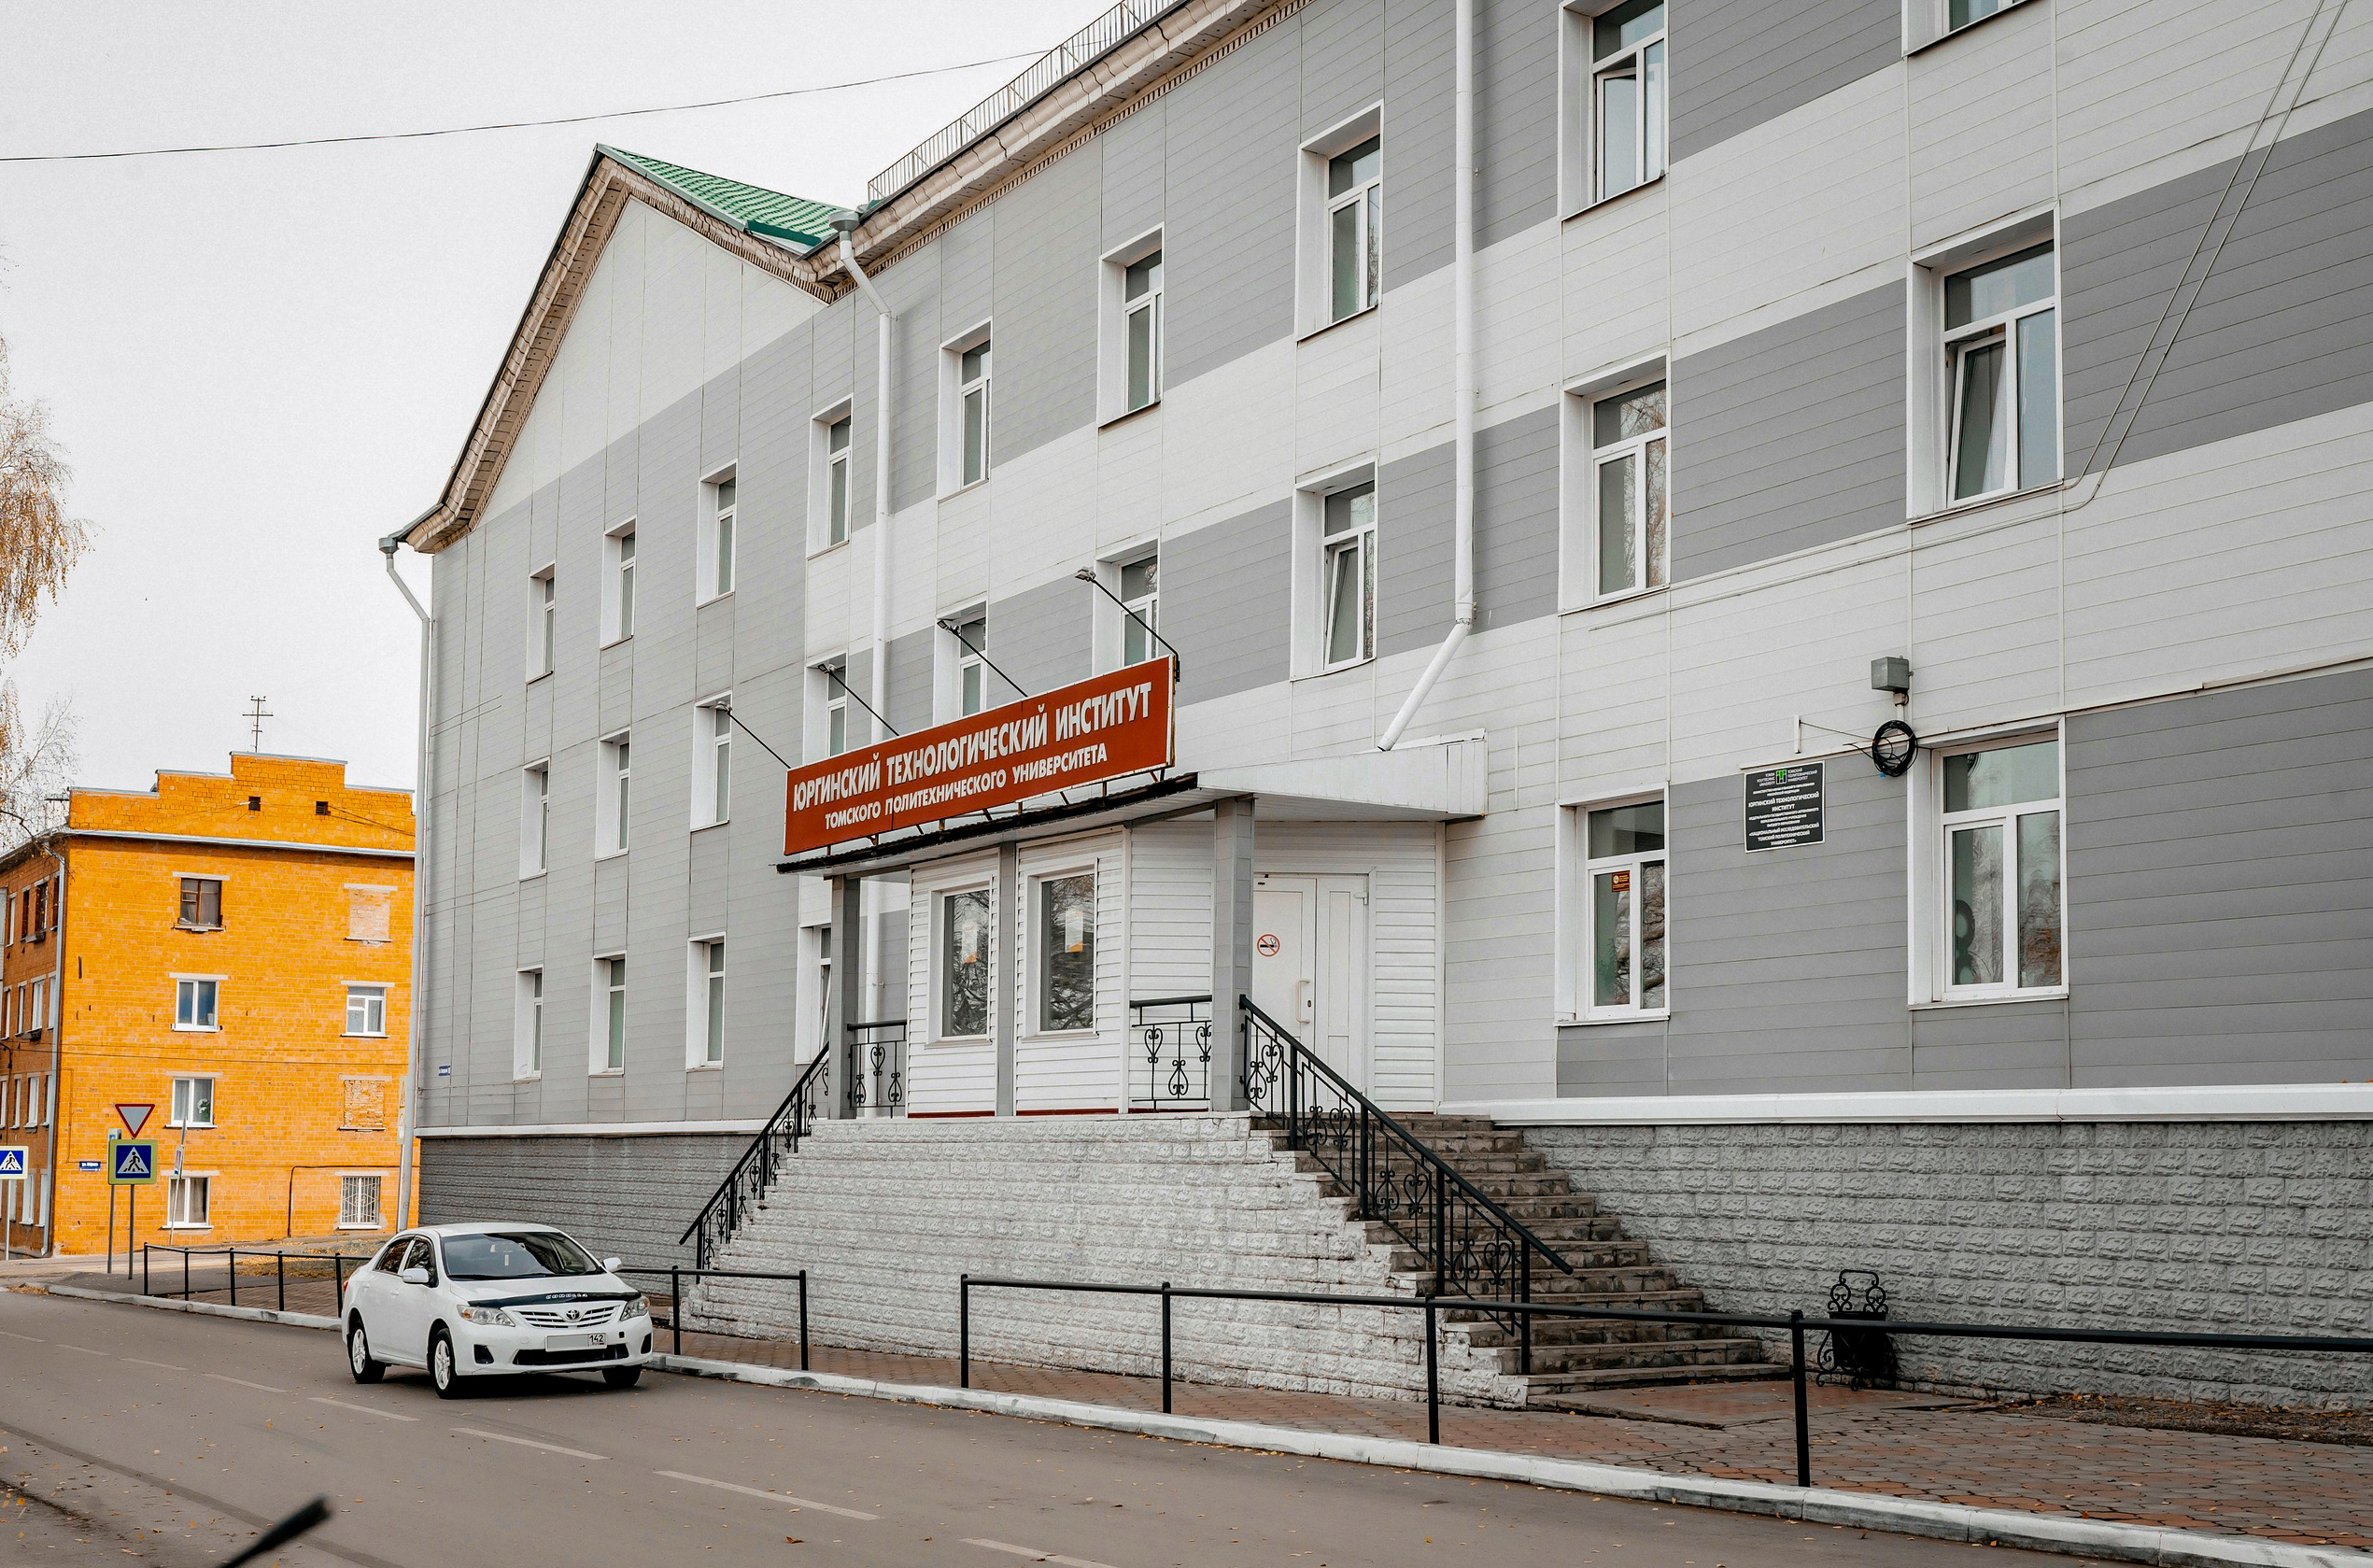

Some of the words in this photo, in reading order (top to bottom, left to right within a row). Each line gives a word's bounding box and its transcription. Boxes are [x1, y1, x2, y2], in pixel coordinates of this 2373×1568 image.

[793, 752, 882, 812] ЮРГИНСКИЙ
[886, 702, 1048, 787] ТЕХНОЛОГИЧЕСКИЙ
[1055, 681, 1152, 742] ИНСТИТУТ
[825, 800, 882, 830] ТОМСКОГО
[884, 769, 1007, 816] ПОЛИТЕХНИЧЕСКОГО
[1012, 742, 1109, 784] УНИВЕРСИТЕТА
[589, 1334, 603, 1342] 142
